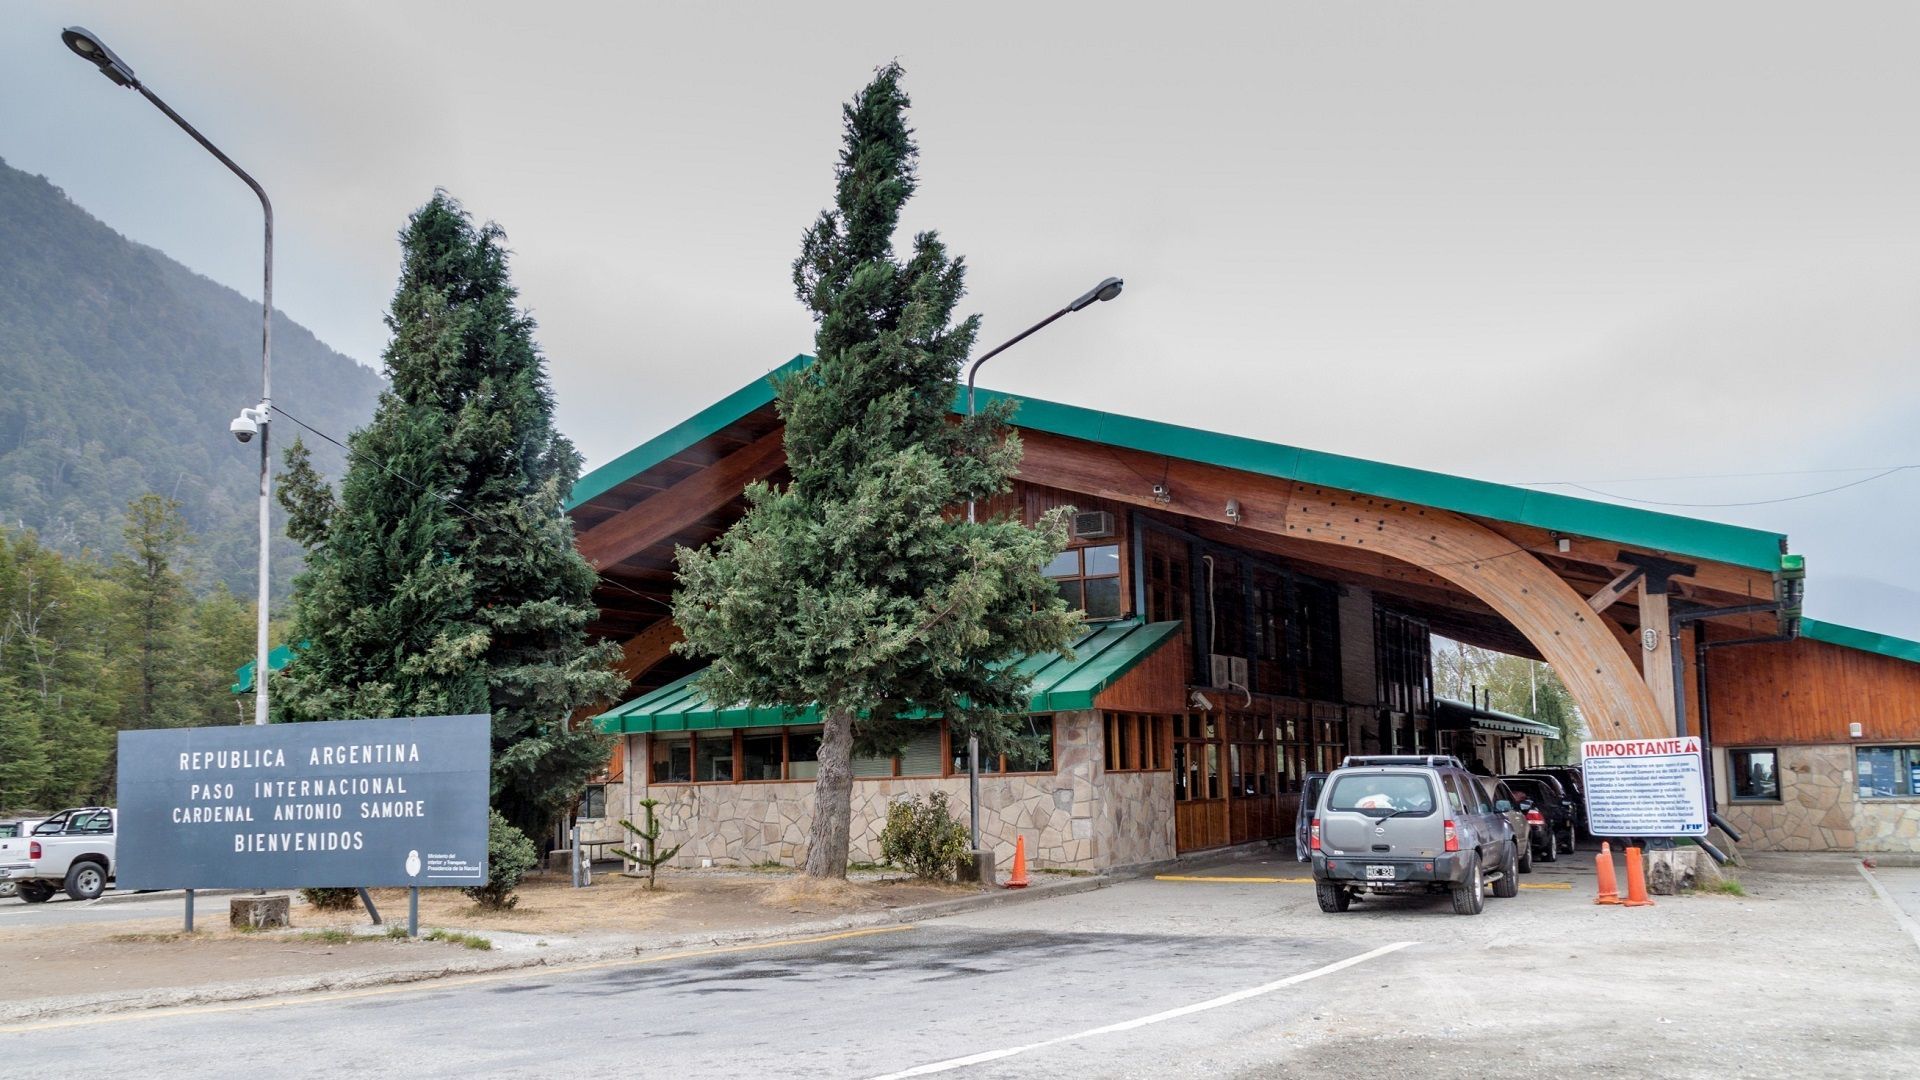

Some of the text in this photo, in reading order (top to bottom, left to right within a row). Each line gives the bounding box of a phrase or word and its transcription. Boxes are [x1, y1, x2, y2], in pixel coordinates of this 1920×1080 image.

[179, 743, 420, 771] REPUBLICA ARGENTINA
[1586, 741, 1682, 757] IMPORTANTE
[191, 777, 407, 800] PASO INTERNACIONAL
[172, 800, 425, 823] CARDENAL ANTONIO SAMORE
[234, 831, 363, 853] BIENVENIDOS
